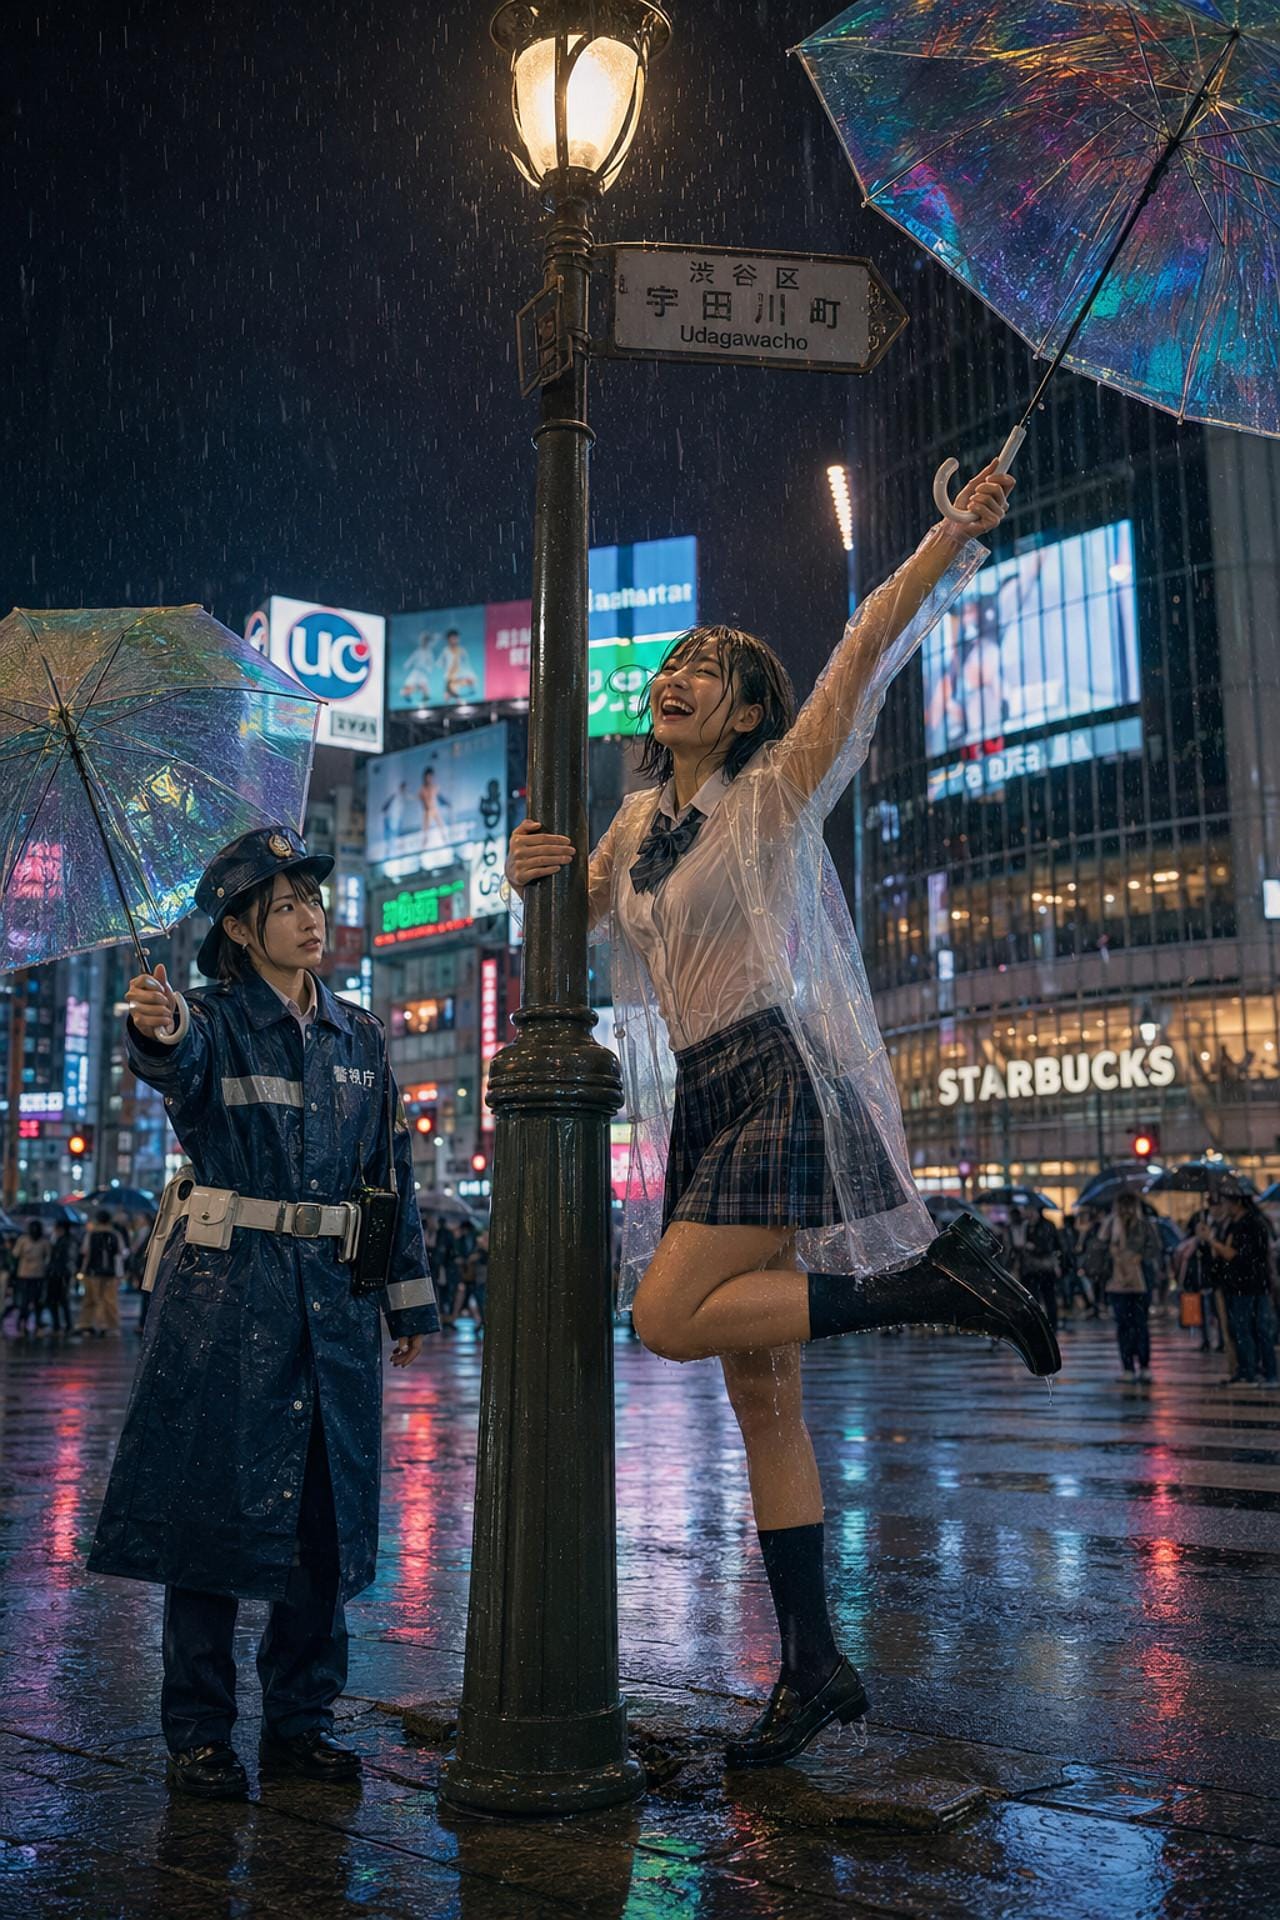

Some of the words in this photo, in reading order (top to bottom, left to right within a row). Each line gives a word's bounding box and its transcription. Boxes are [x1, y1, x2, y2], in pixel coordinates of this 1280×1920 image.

[690, 261, 799, 290] 渋谷区
[646, 286, 841, 329] 宇田川町
[680, 325, 808, 350] Udagawacho
[938, 1045, 1175, 1106] STARBUCKS
